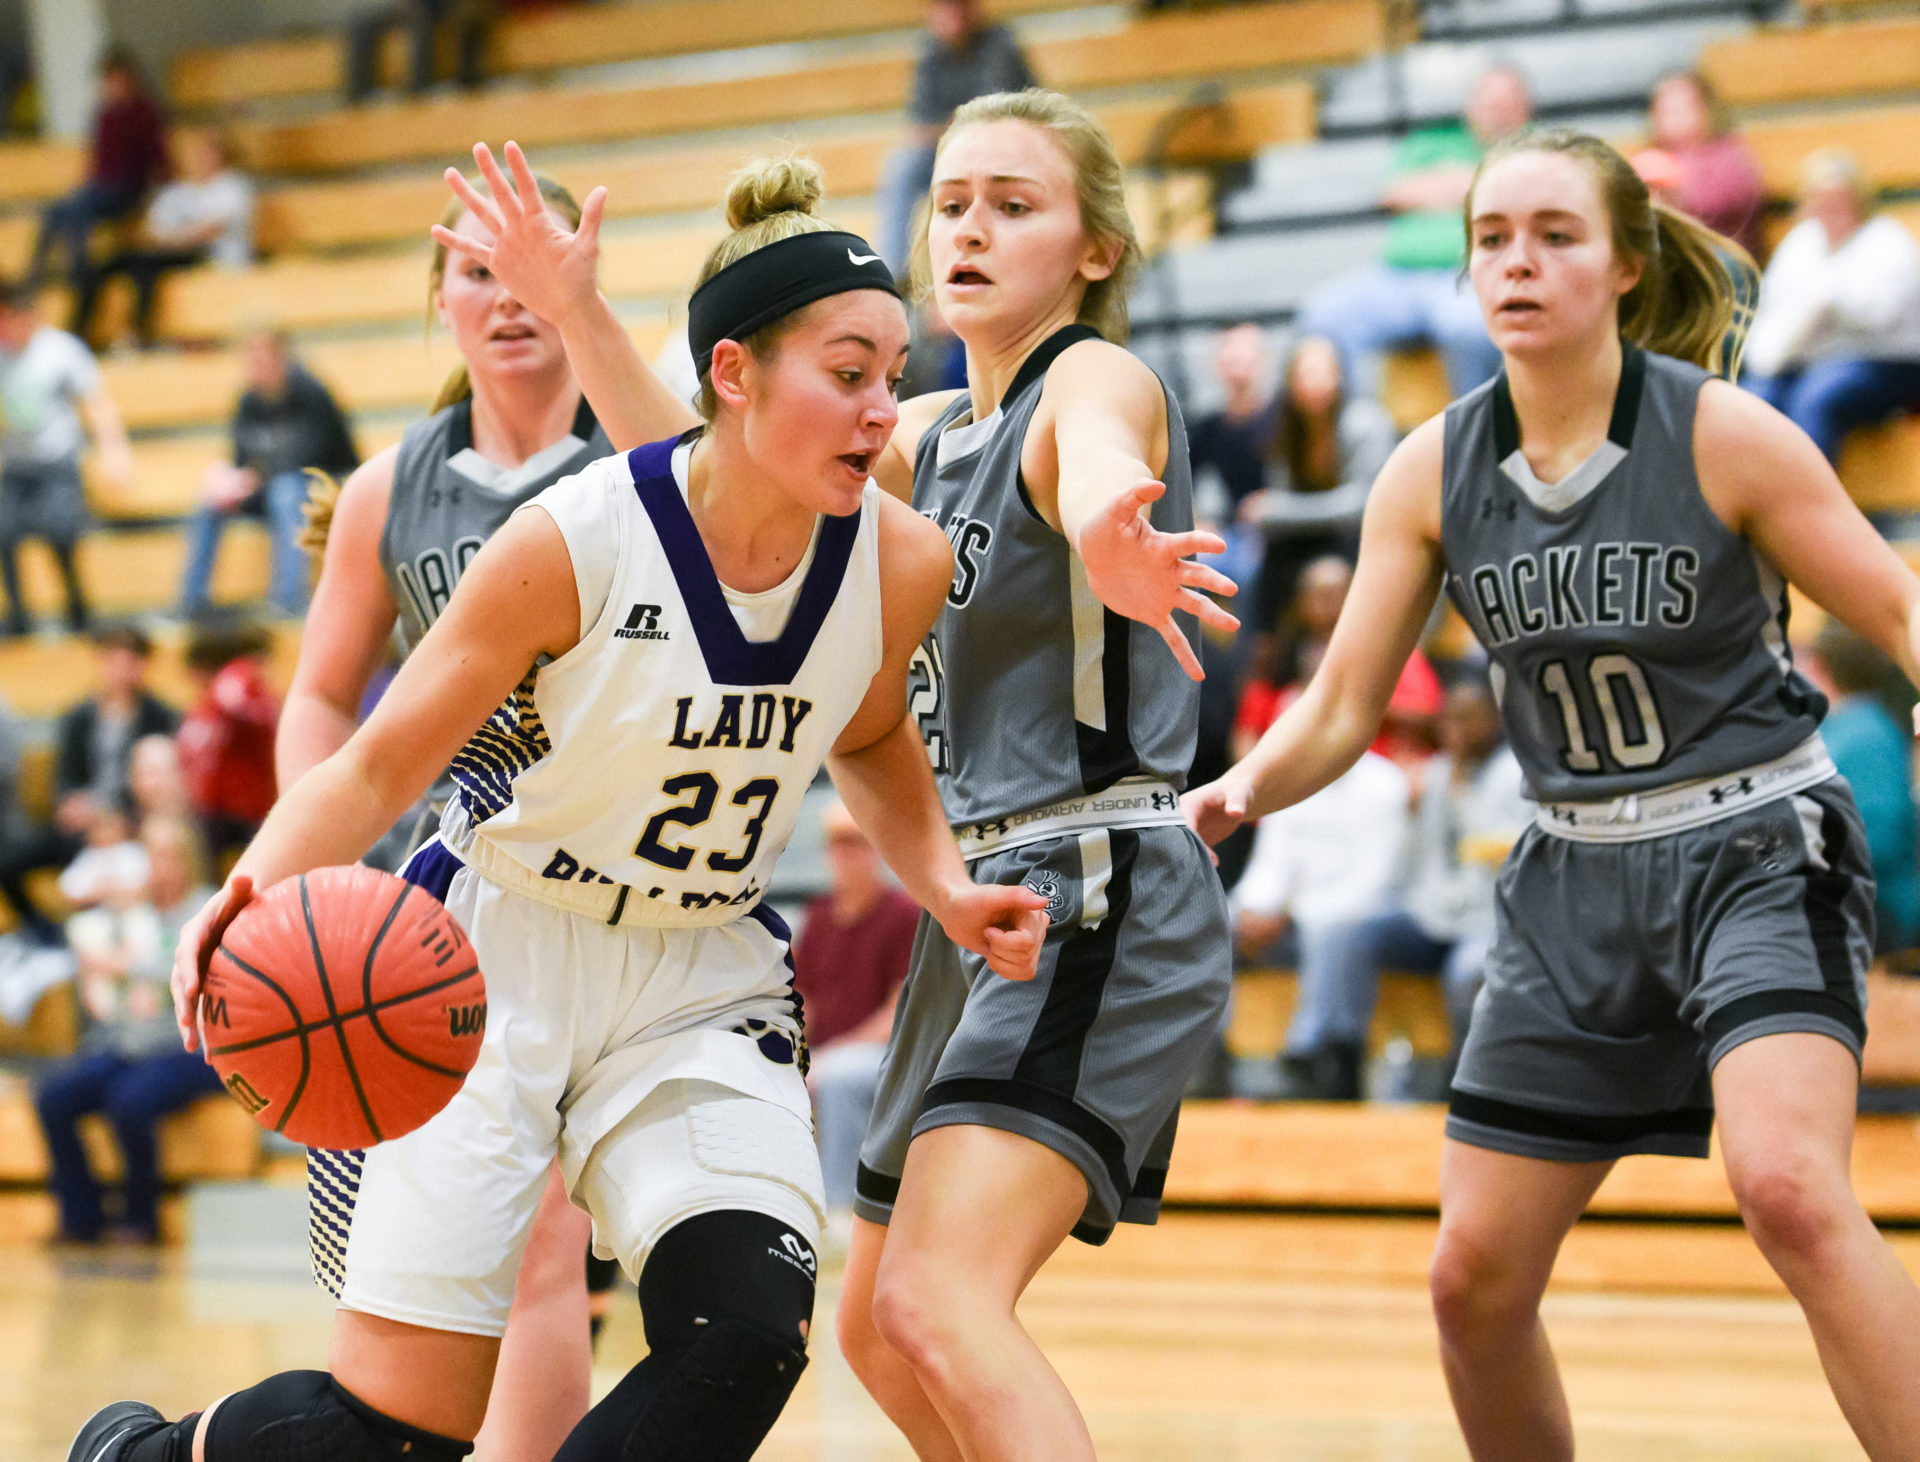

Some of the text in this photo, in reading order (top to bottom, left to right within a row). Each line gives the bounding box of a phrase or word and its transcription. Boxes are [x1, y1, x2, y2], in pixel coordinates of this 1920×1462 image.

[613, 628, 670, 641] RUSSELL
[666, 692, 813, 754] LADY
[1539, 652, 1667, 776] 10
[630, 769, 781, 874] 23
[1013, 796, 1148, 827] UNDER ARMOUR
